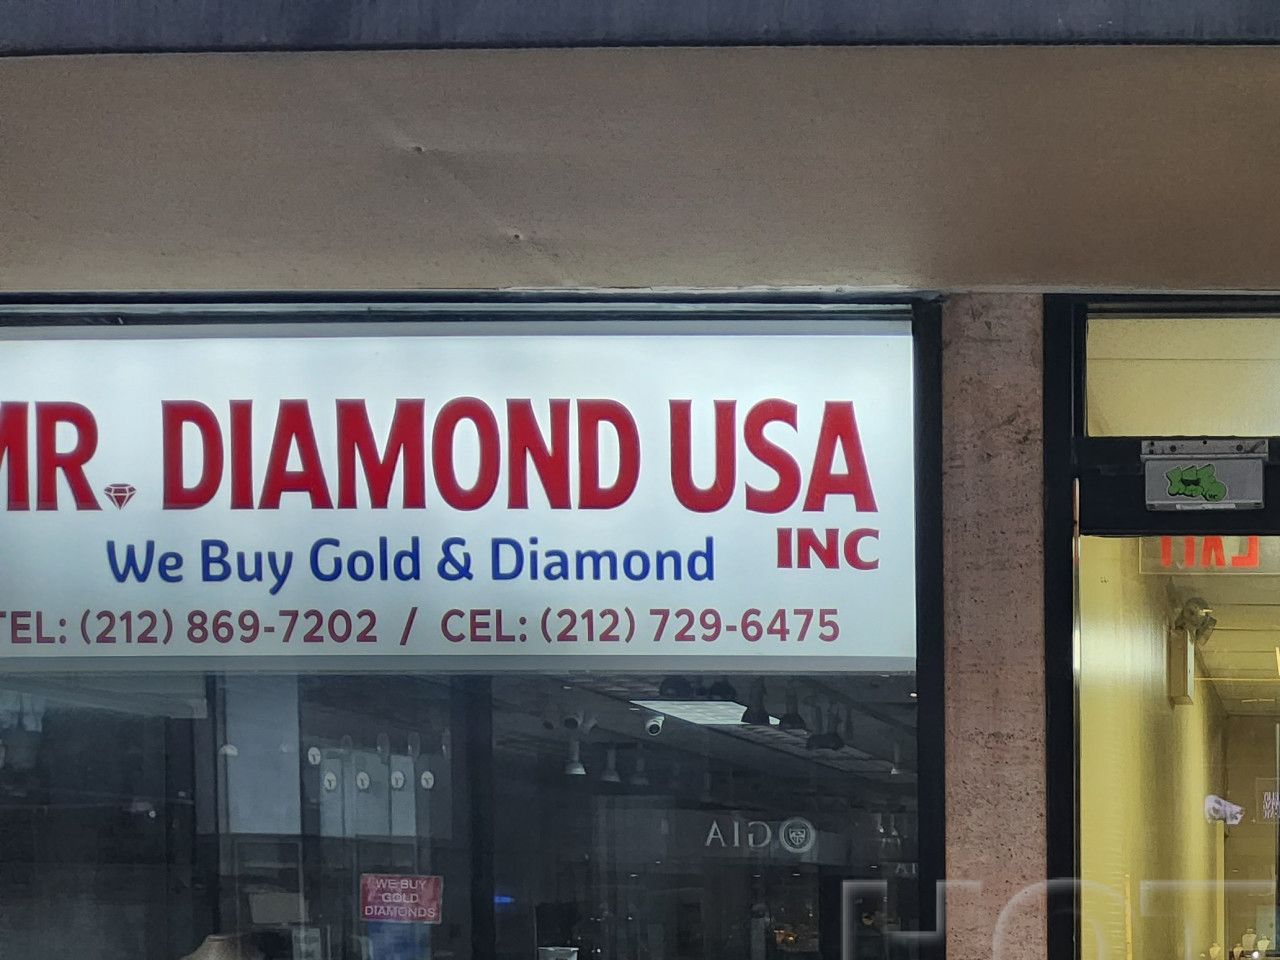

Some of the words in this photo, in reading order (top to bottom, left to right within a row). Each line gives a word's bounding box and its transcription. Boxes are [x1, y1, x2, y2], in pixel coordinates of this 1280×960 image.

[161, 396, 641, 512] DIAMOND
[668, 398, 879, 514] USA
[106, 540, 184, 584] We
[201, 539, 293, 596] Buy
[309, 536, 420, 583] Gold
[436, 536, 474, 582] &
[491, 535, 715, 582] Diamond
[776, 527, 880, 571] INC
[0, 610, 67, 645] EL:
[80, 608, 173, 646] (212)
[186, 609, 378, 644] 869-7202
[440, 608, 528, 643] CEL:
[540, 607, 636, 645] (212)
[649, 608, 841, 643] 729-6475
[375, 879, 397, 889] WE
[400, 879, 427, 890] BUY
[381, 892, 419, 904] GOLD
[364, 905, 436, 918] DIAMONDS
